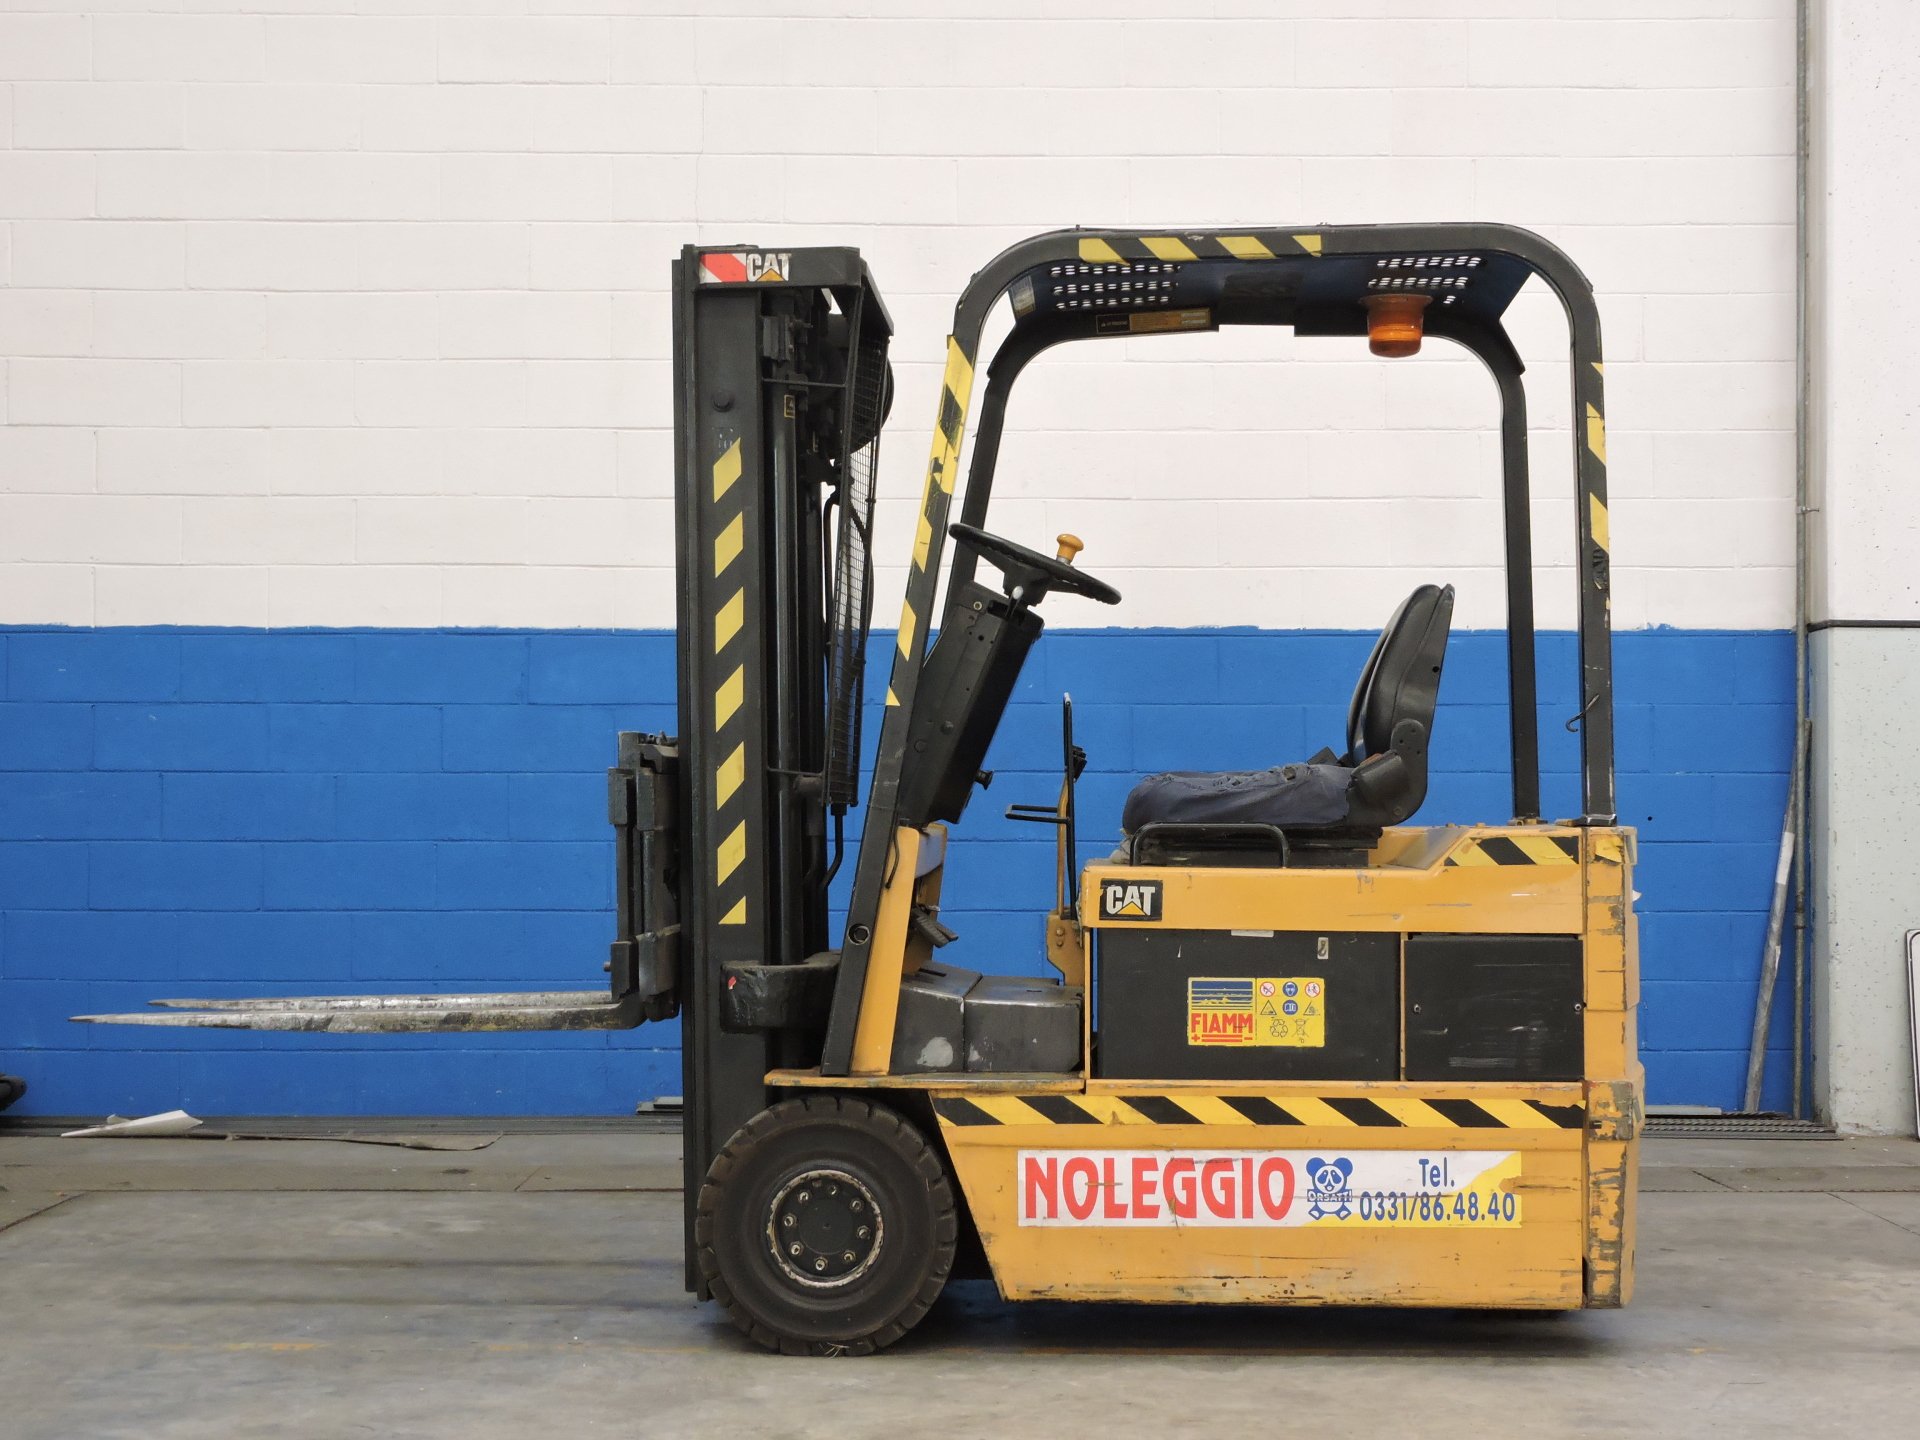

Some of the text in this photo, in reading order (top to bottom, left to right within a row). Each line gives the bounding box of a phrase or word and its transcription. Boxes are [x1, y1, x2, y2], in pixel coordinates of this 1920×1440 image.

[746, 253, 792, 282] CAT
[1106, 885, 1156, 916] CAT
[1190, 1012, 1254, 1034] FIAMM
[1418, 1156, 1456, 1188] Tel.
[1024, 1156, 1296, 1221] NOLEGGIO
[1306, 1189, 1353, 1203] ORSATTI
[1359, 1191, 1516, 1222] 0331/86.48.40
